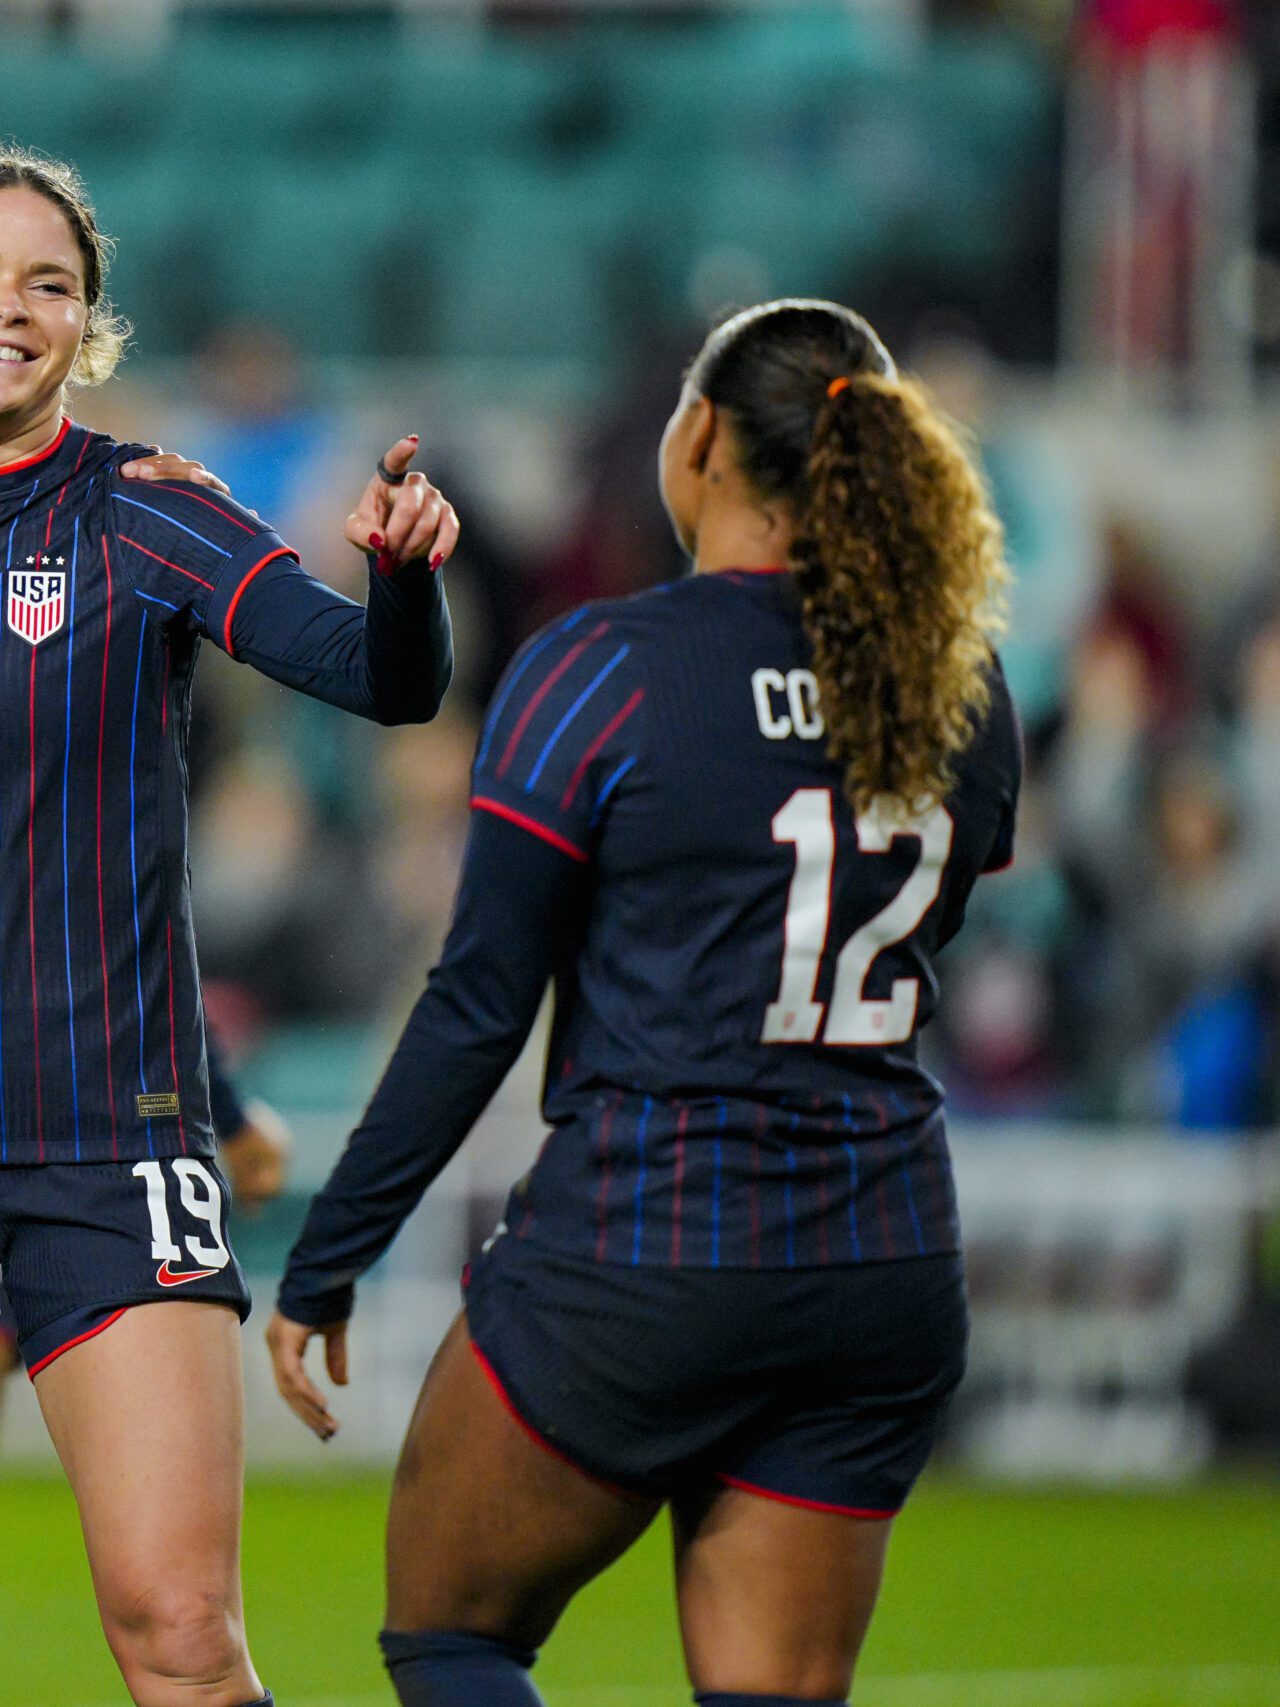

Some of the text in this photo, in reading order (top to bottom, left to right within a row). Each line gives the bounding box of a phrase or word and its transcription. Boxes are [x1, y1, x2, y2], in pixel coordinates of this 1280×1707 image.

[12, 574, 62, 604] USA
[760, 787, 954, 1045] 12
[131, 1158, 231, 1269] 19
